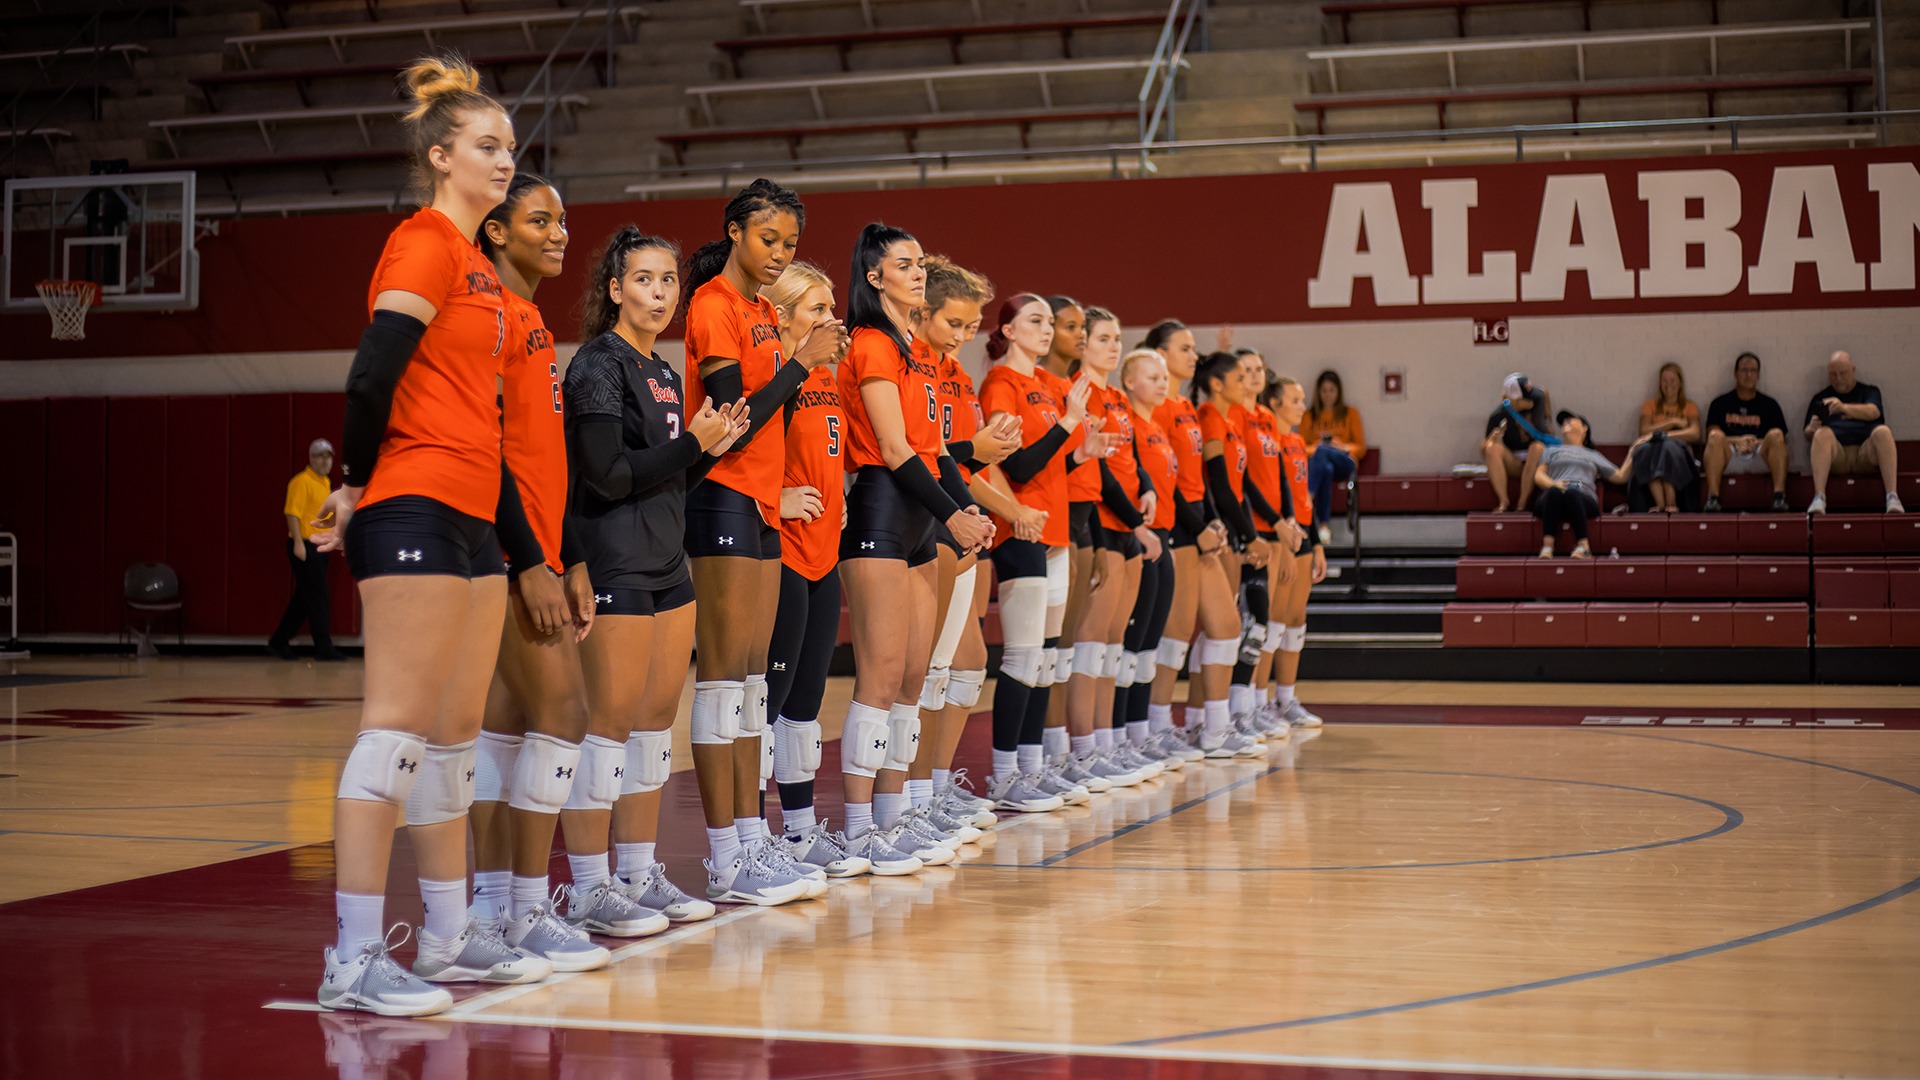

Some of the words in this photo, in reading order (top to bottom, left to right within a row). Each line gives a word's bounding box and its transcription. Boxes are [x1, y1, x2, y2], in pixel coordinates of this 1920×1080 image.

[492, 308, 505, 356] 1
[549, 362, 563, 414] 2
[647, 378, 680, 405] Bears
[793, 391, 841, 412] MERCE
[924, 383, 936, 423] 6
[826, 415, 839, 457] 5
[942, 403, 952, 441] 8
